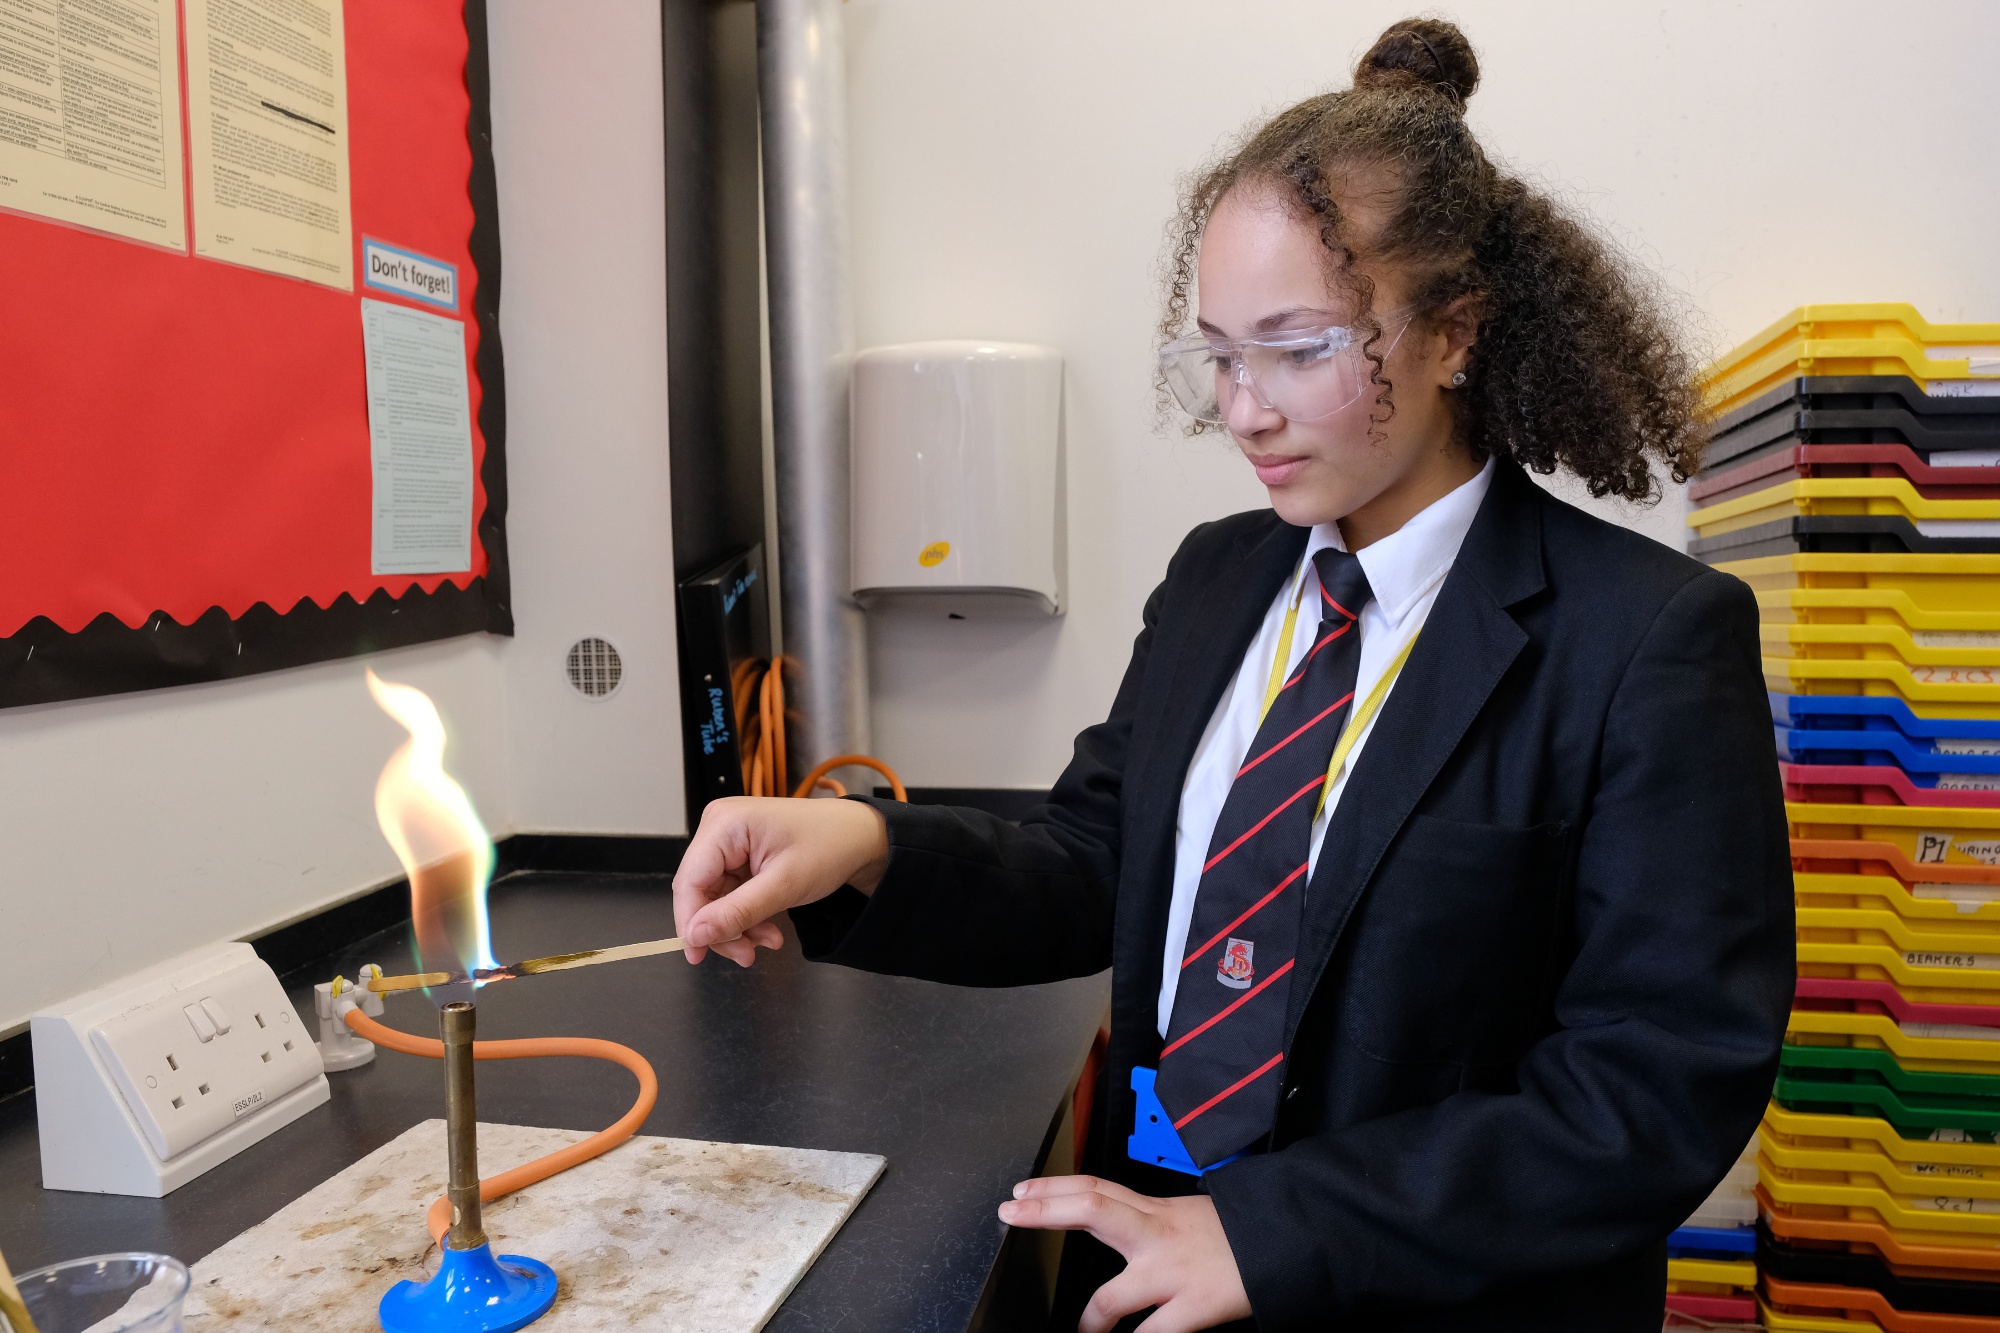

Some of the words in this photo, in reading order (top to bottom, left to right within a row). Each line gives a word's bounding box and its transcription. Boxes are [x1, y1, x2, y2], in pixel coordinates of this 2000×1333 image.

[371, 254, 408, 283] Don't
[411, 264, 451, 295] forget!
[1919, 834, 1946, 863] P1
[1907, 953, 1975, 967] BEAKERS
